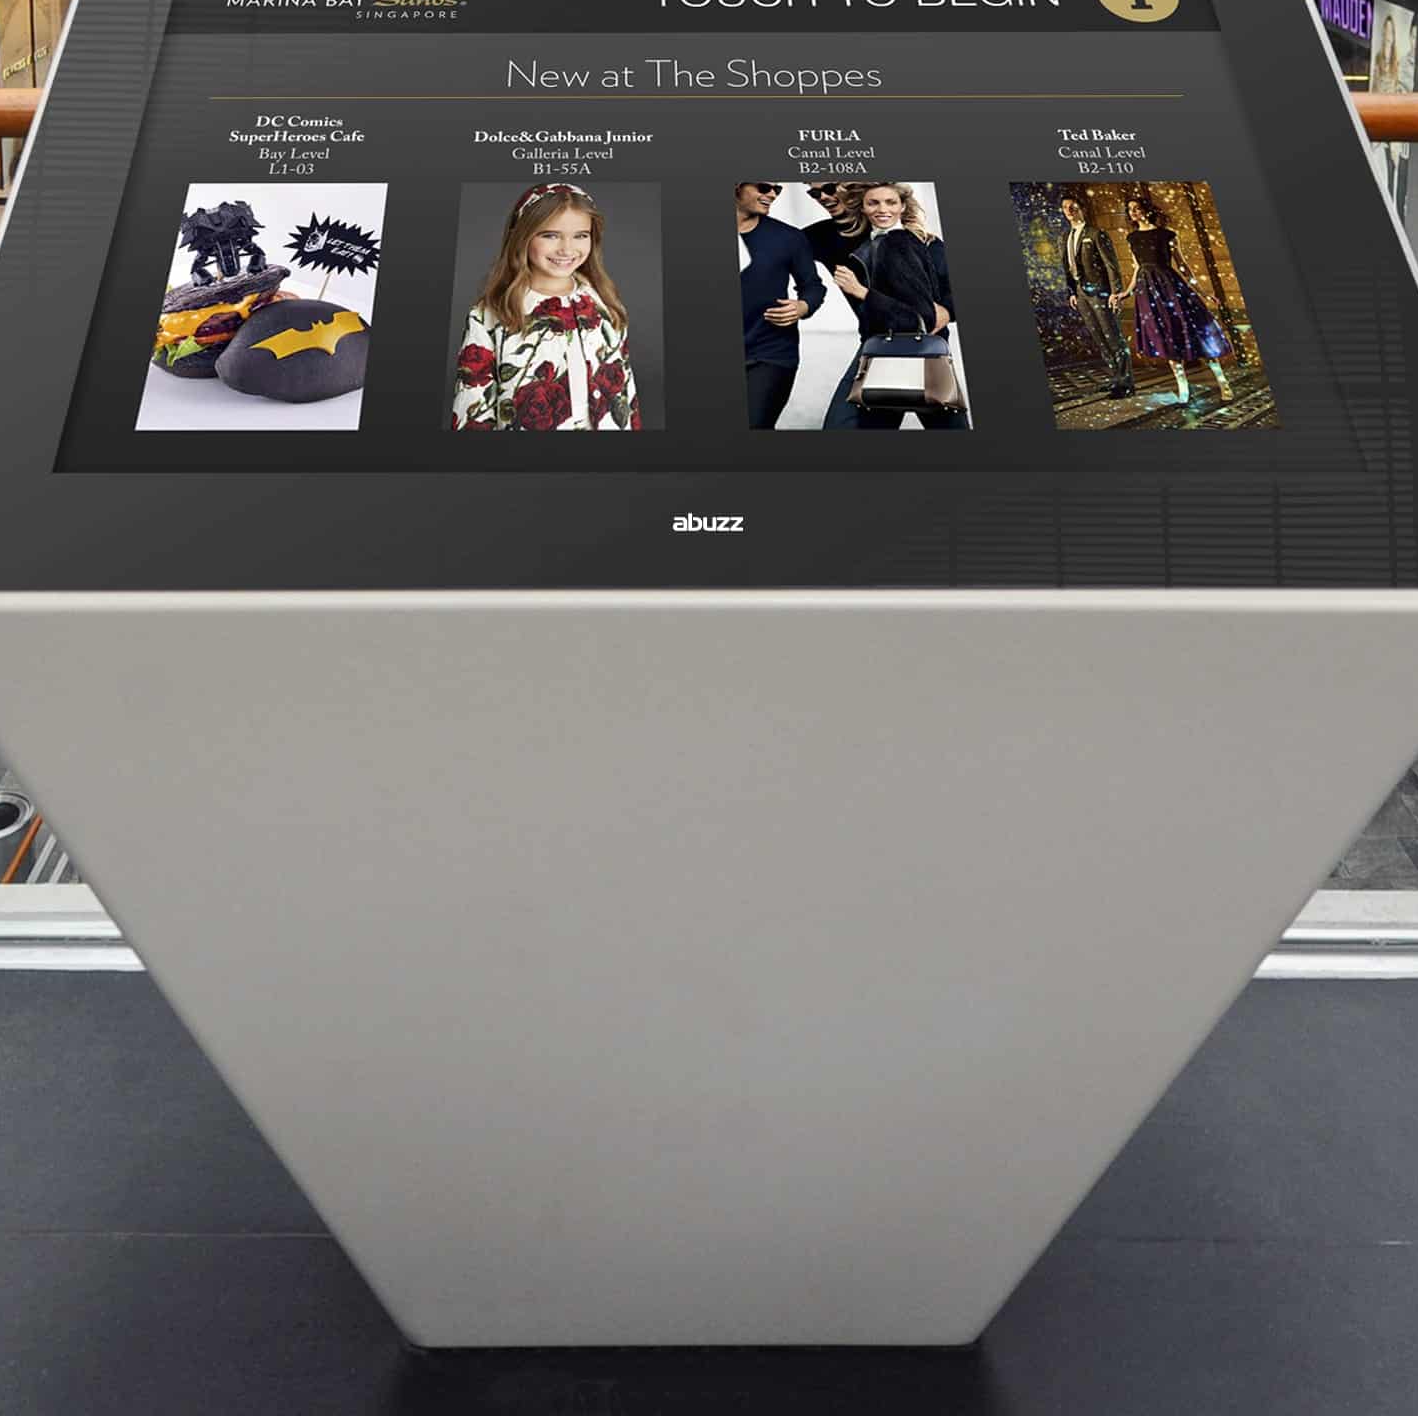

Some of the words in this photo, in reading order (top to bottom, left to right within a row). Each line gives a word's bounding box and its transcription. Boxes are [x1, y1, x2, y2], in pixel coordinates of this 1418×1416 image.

[355, 10, 458, 20] SINGAPORE
[507, 59, 590, 88] New
[601, 66, 635, 88] at
[644, 59, 716, 88] The
[726, 58, 883, 95] Shoppes
[255, 115, 285, 128] DC
[287, 115, 344, 128] Comics
[228, 130, 326, 146] SuperHeroes
[329, 129, 365, 142] Cafe
[474, 130, 602, 143] Dolce&Gabbana
[604, 130, 654, 144] Junior
[798, 129, 861, 142] FURLA
[1057, 128, 1086, 141] Ted
[1090, 128, 1137, 141] Baker
[258, 147, 287, 164] Bay
[290, 147, 331, 160] Level
[511, 147, 570, 160] Galleria
[574, 147, 614, 160] Level
[787, 146, 832, 159] Canal
[835, 146, 876, 159] Level
[1057, 146, 1102, 159] Canal
[1105, 146, 1146, 159] Level
[268, 162, 315, 175] L1-03
[533, 162, 592, 175] B1-55A
[799, 161, 868, 174] B2-108A
[1077, 161, 1134, 174] B2-110
[672, 512, 744, 532] abuzz
